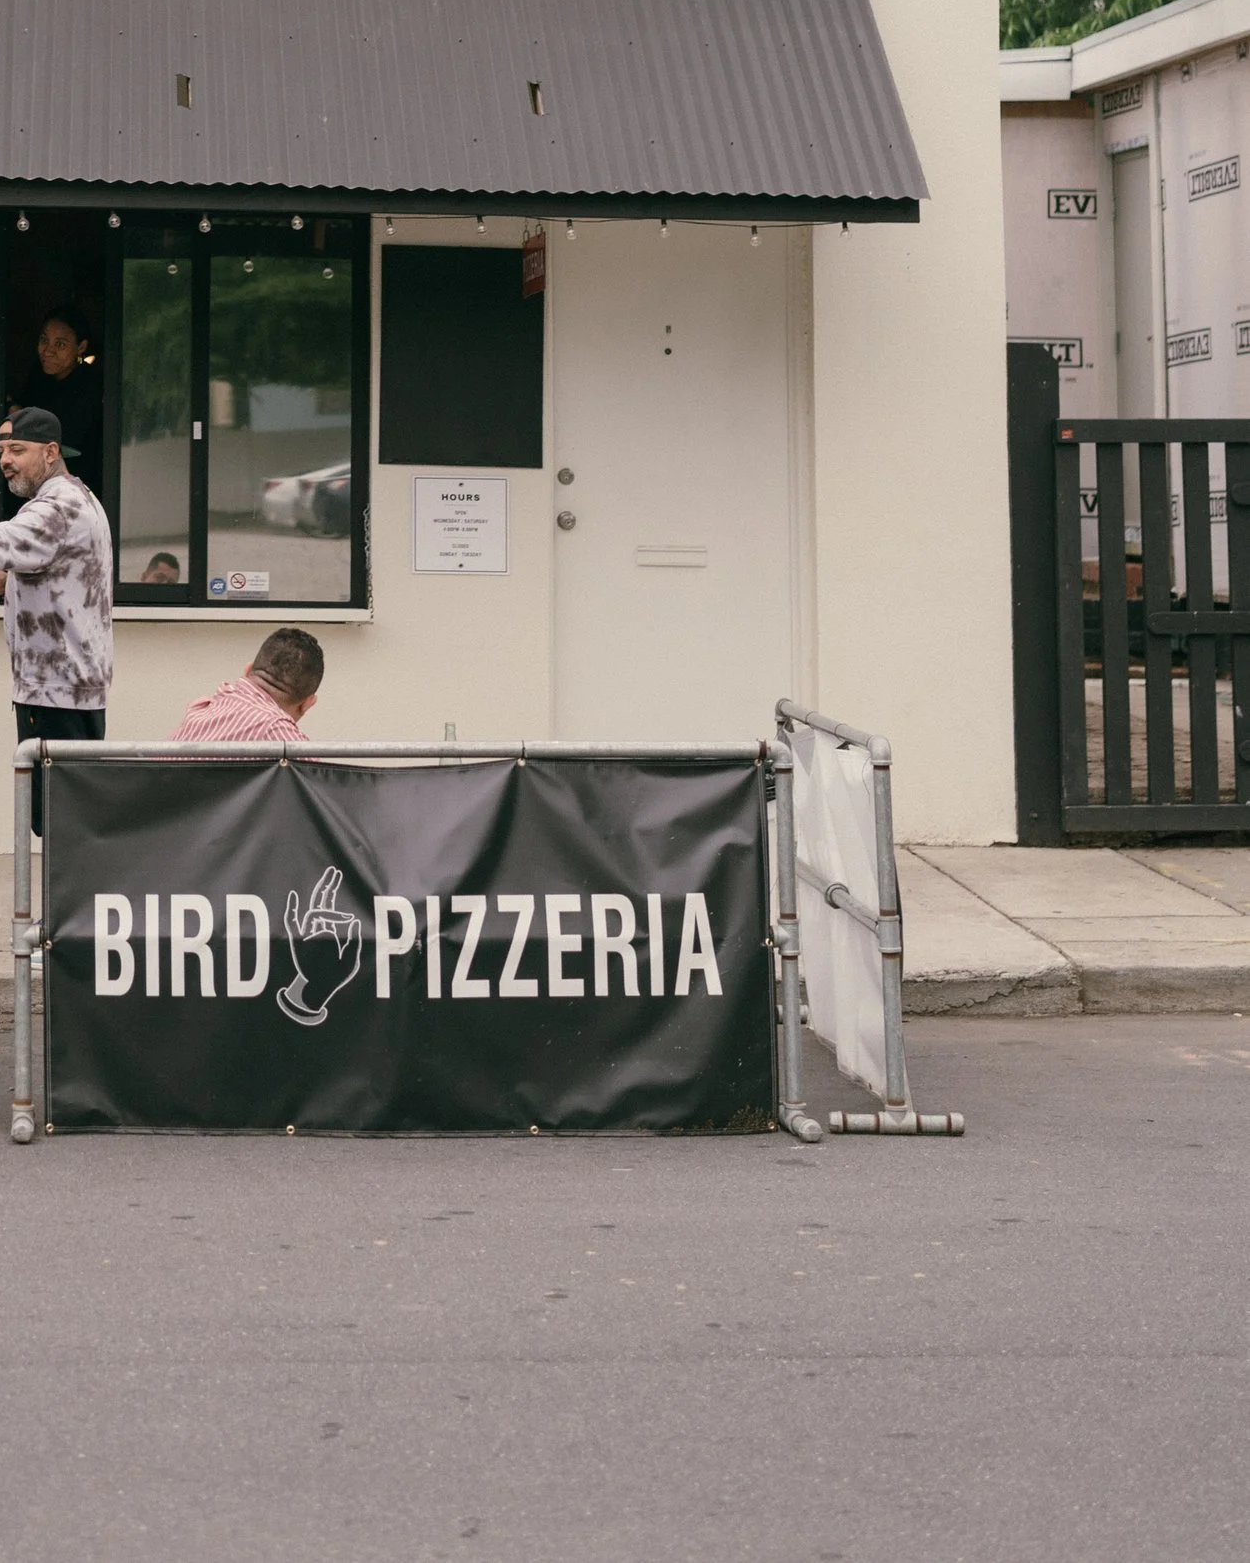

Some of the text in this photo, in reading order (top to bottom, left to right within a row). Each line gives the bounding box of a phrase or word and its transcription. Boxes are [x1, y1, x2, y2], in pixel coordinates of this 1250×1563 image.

[1190, 161, 1238, 196] EVERBILT
[441, 493, 480, 501] HOURS
[93, 892, 724, 1000] BIRD PIZZERIA
